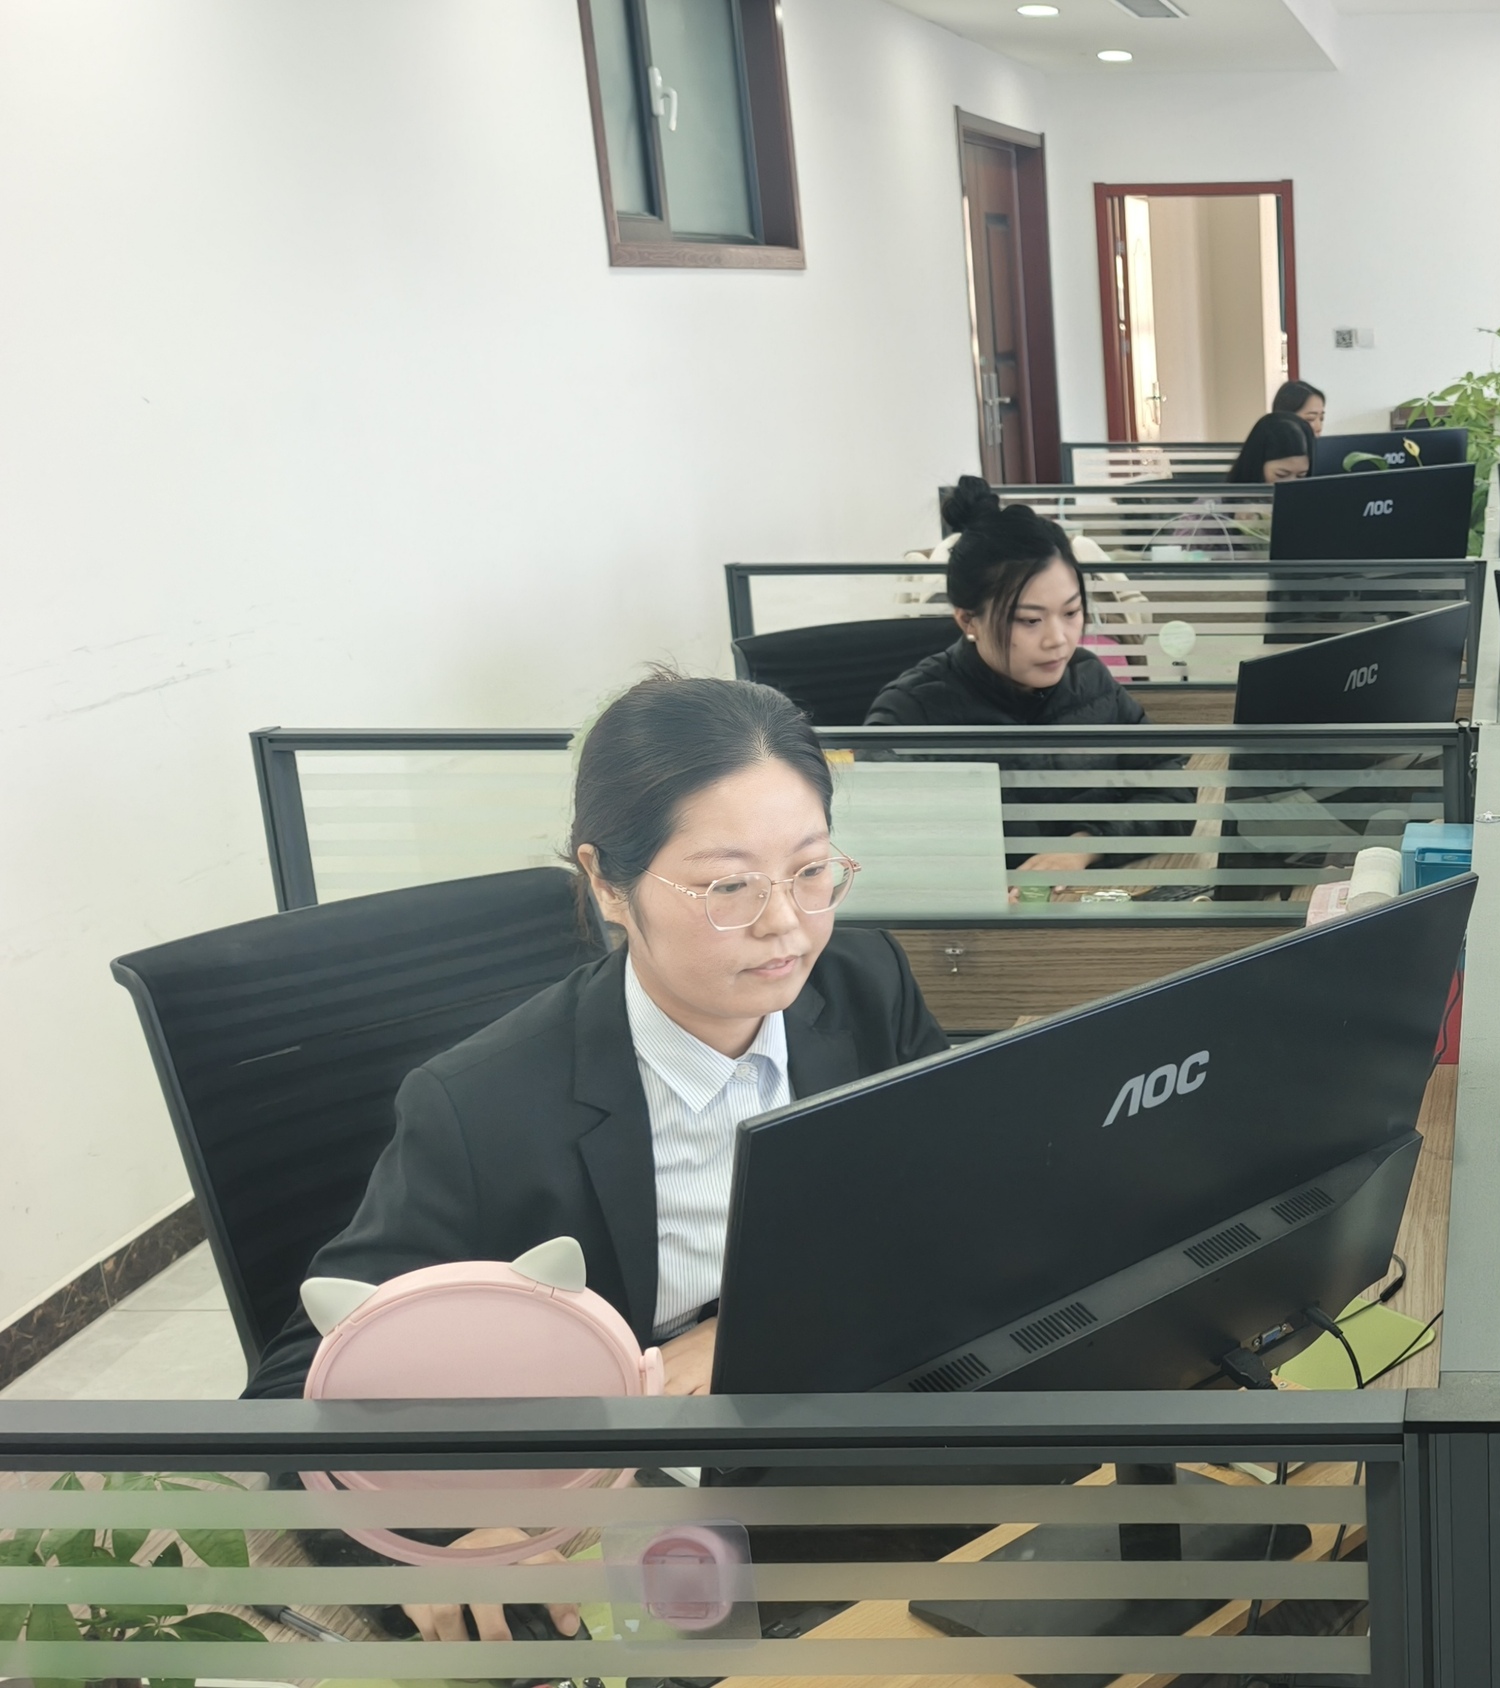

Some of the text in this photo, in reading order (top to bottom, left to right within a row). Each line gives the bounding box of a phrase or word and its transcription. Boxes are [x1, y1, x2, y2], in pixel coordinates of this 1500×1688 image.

[1363, 499, 1394, 517] AOC
[1343, 663, 1379, 692] AOC
[1102, 1050, 1210, 1128] AOC
